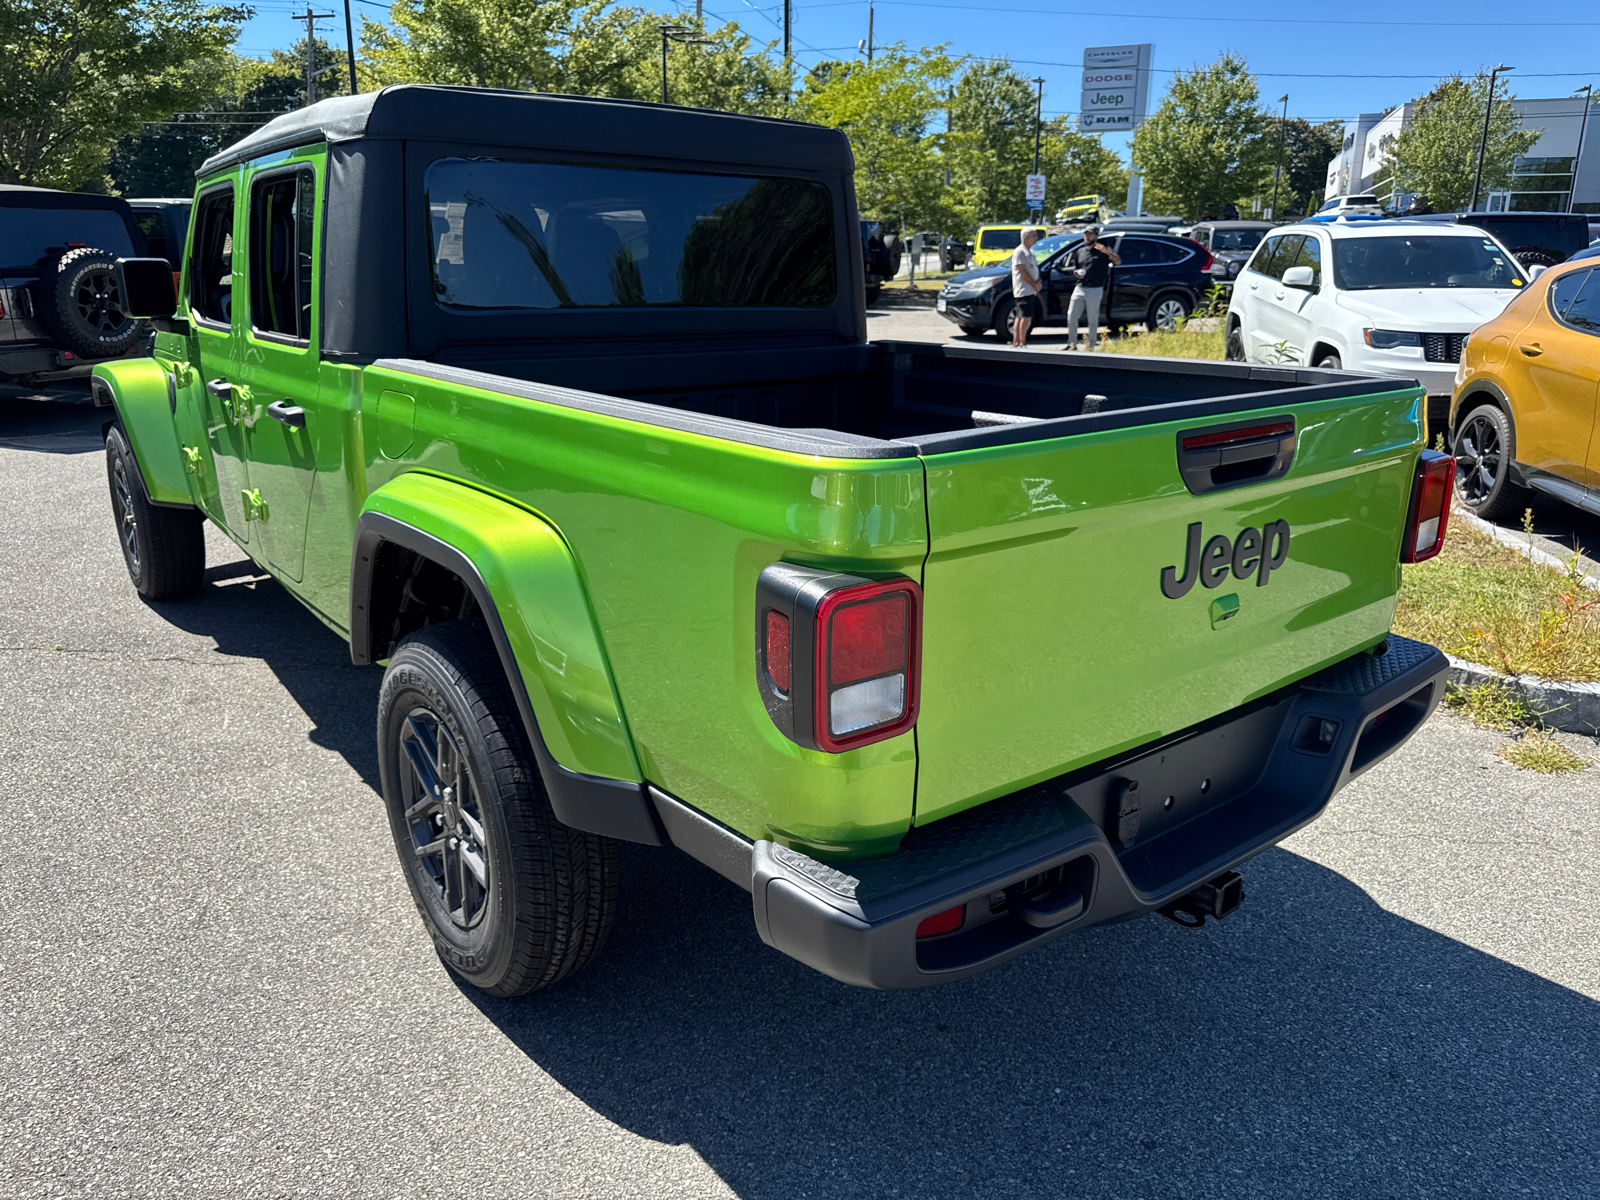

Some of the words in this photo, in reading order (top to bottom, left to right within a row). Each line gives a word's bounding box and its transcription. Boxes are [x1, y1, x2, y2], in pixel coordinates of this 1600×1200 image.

[1085, 74, 1132, 82] DODGE
[1090, 92, 1124, 106] Jeep
[1160, 518, 1291, 600] Jeep
